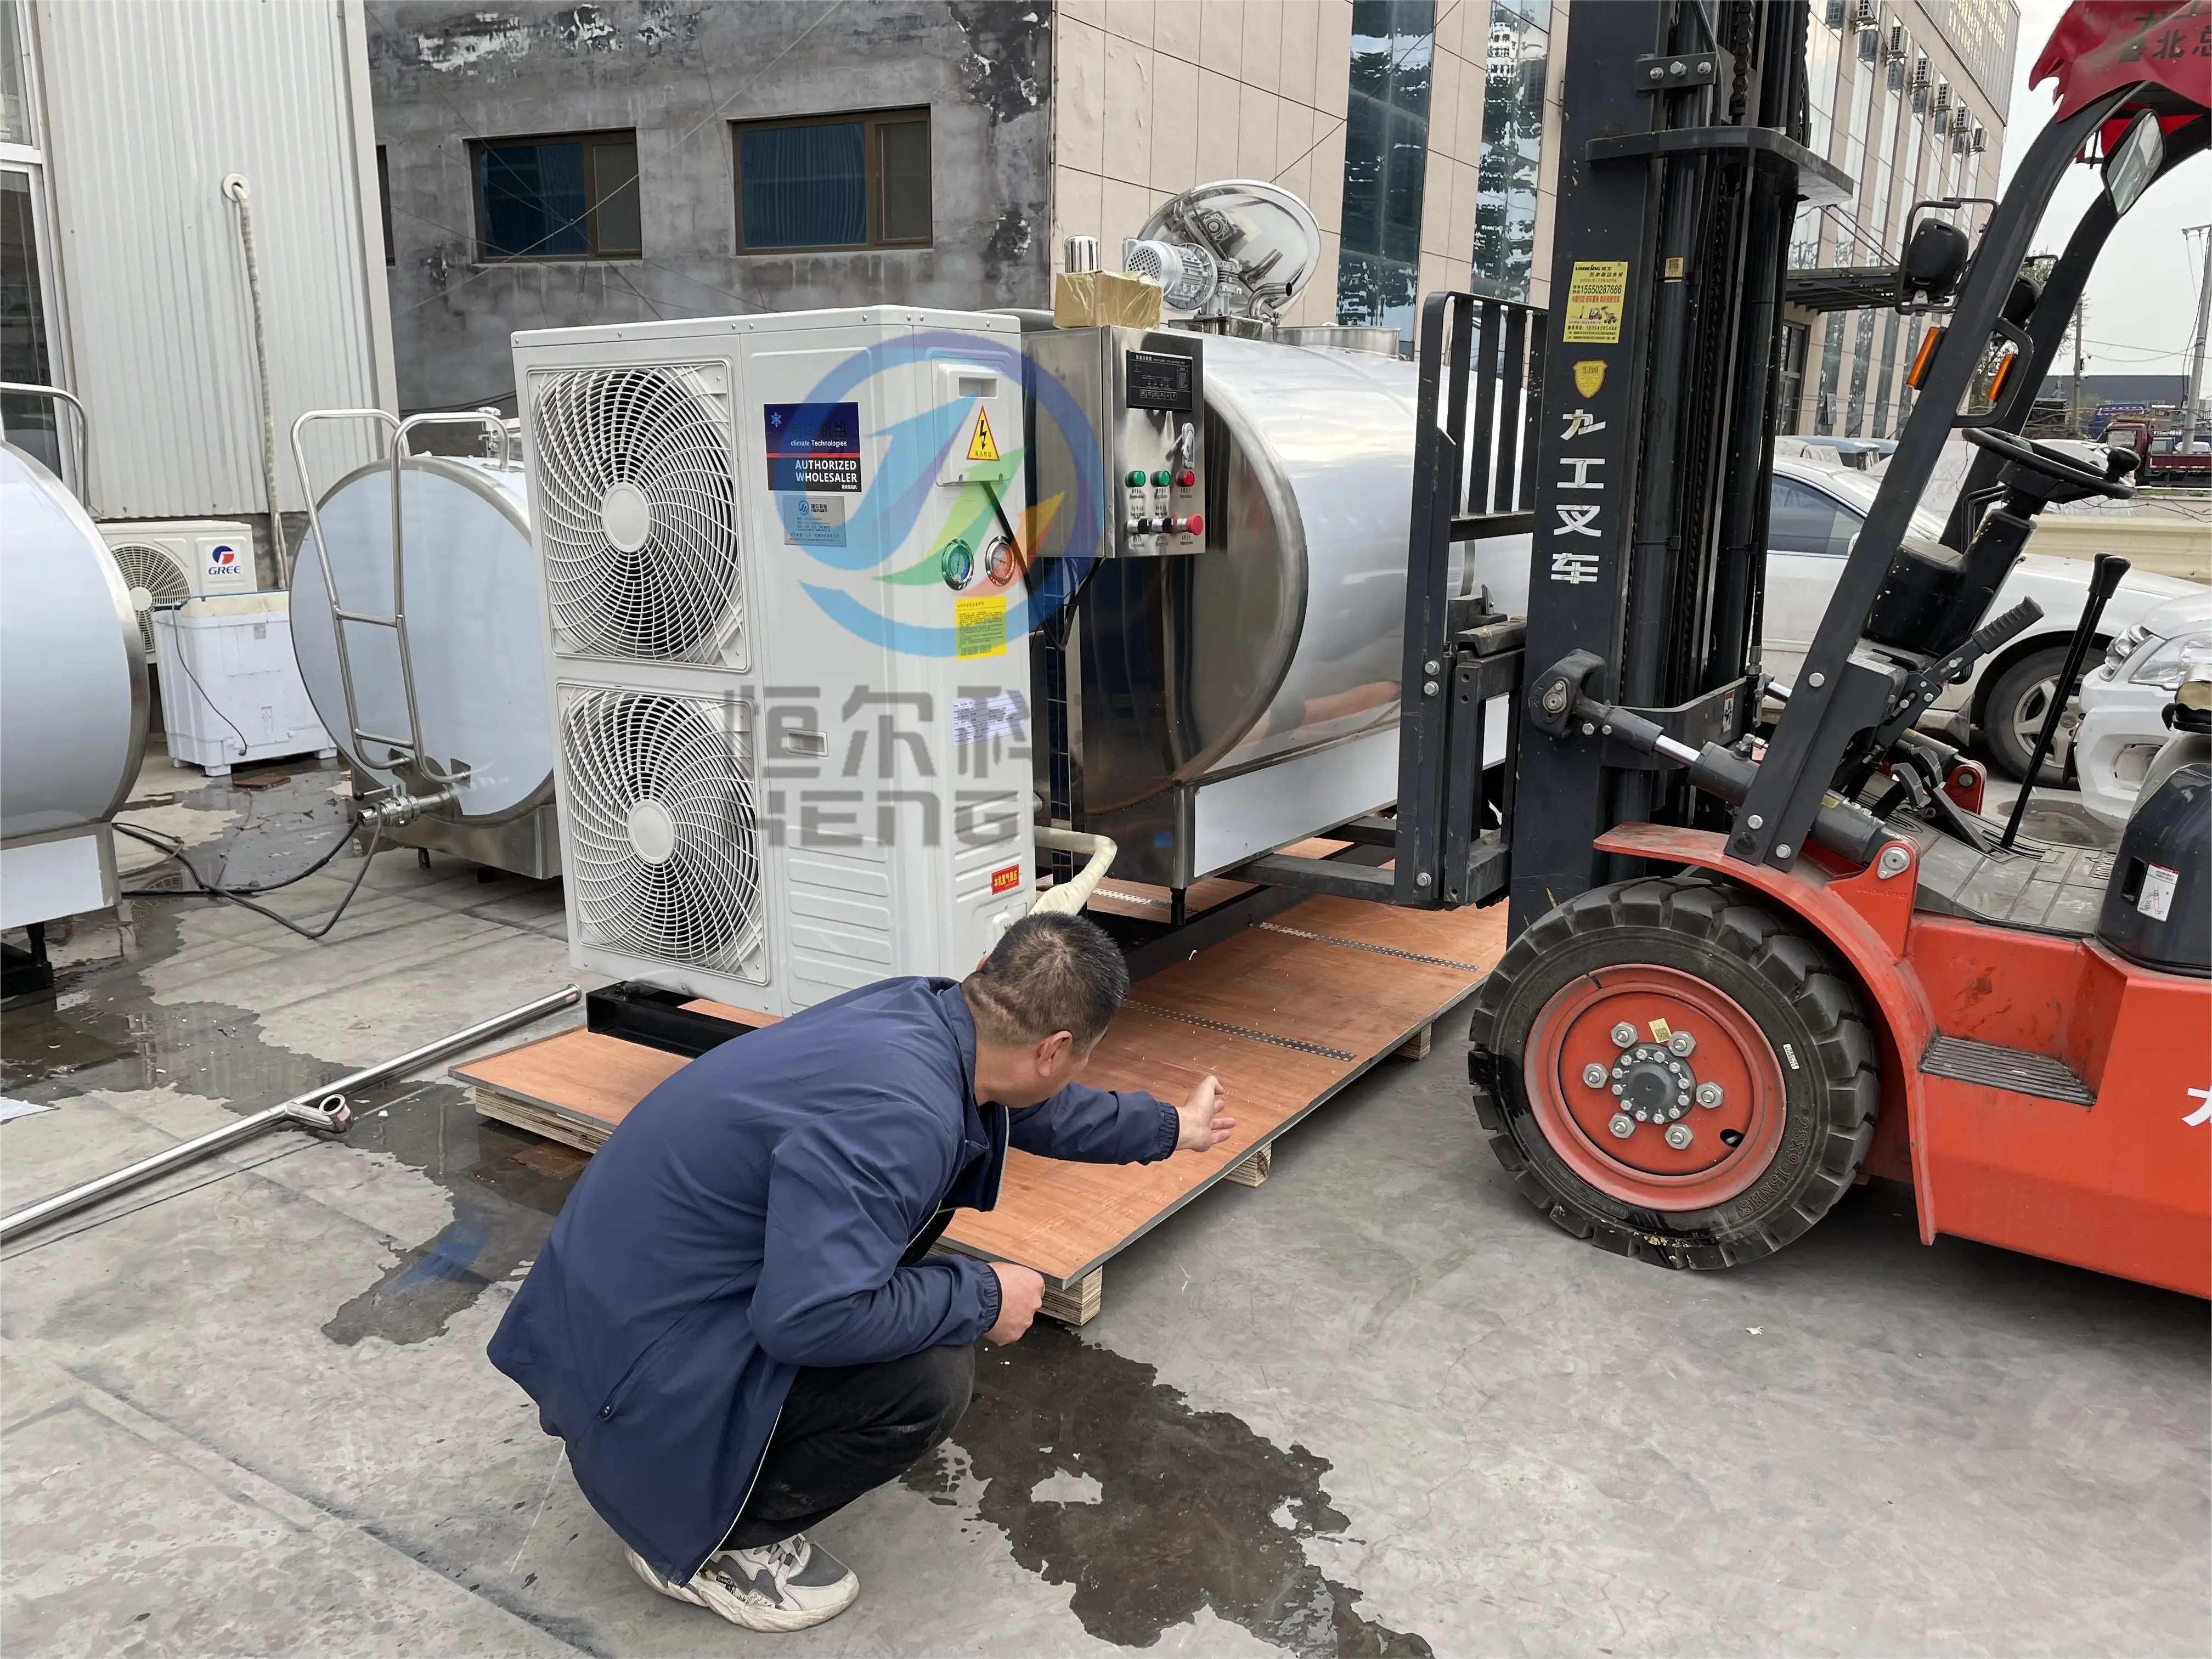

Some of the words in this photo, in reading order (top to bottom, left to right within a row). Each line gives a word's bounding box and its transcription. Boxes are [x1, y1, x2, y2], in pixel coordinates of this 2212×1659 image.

[1581, 285, 1622, 294] 15550287666
[811, 439, 848, 448] Technologies
[795, 460, 856, 470] AUTHORIZED
[795, 472, 857, 483] WHOLESALER
[208, 565, 241, 574] GREE
